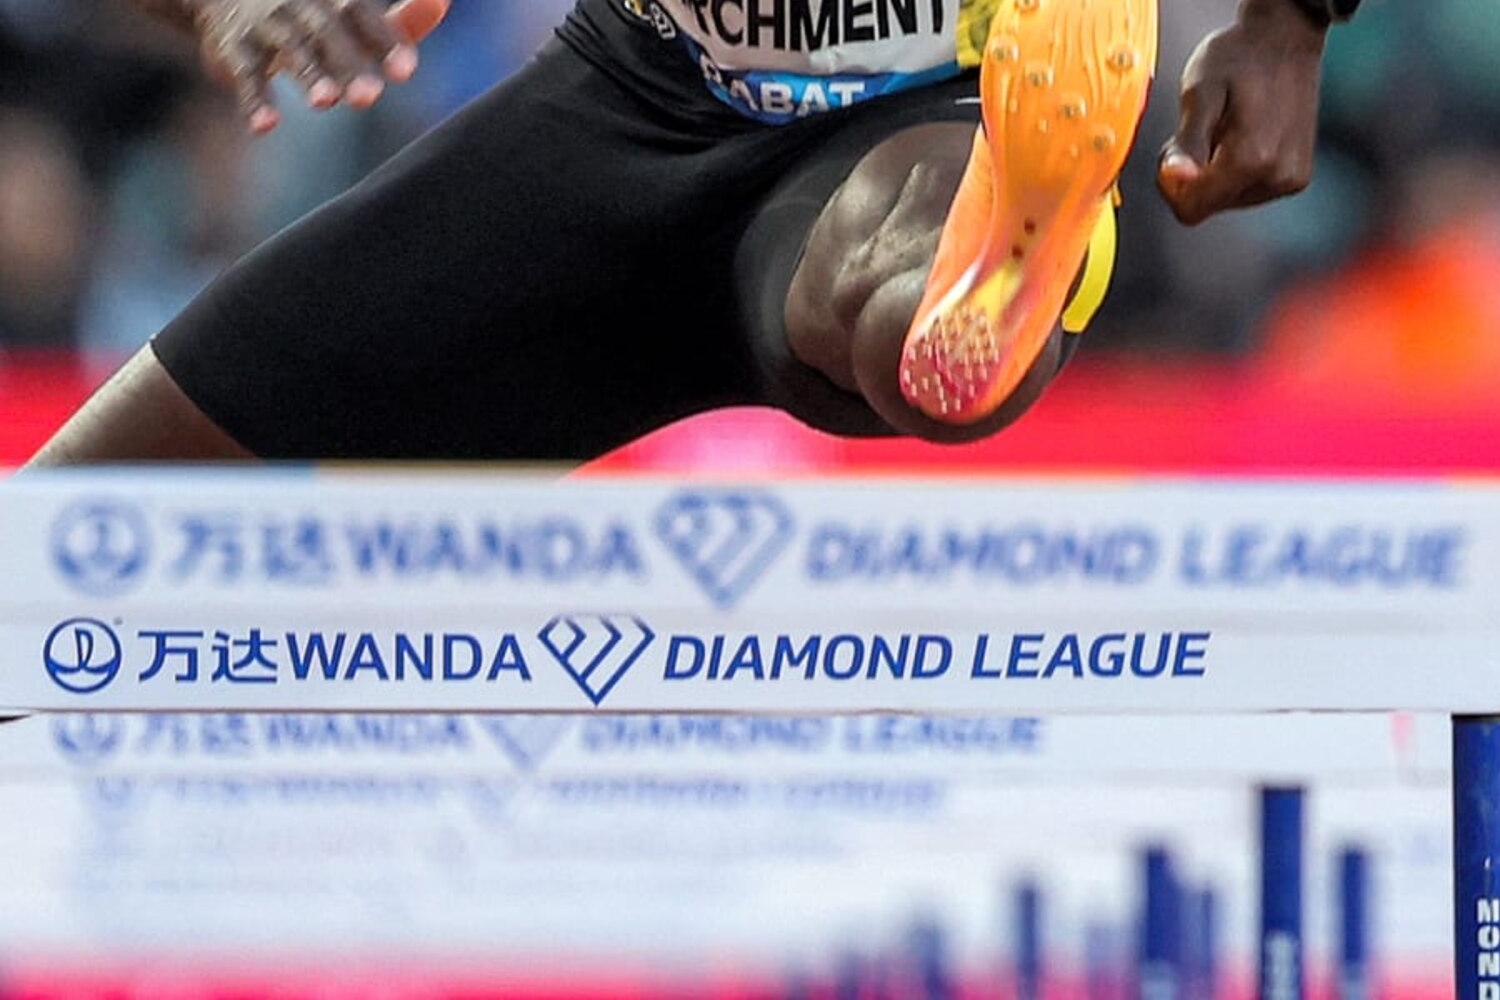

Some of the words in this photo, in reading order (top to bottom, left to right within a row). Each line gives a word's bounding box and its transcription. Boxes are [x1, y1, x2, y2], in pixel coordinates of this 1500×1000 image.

[700, 53, 866, 118] RABAT
[343, 516, 646, 582] WANDA
[804, 521, 1159, 584] DIAMOND
[1178, 525, 1465, 588] LEAGUE
[137, 628, 278, 683] 万达
[285, 632, 532, 680] WANDA
[662, 634, 953, 680] DIAMOND
[970, 632, 1211, 679] LEAGUE
